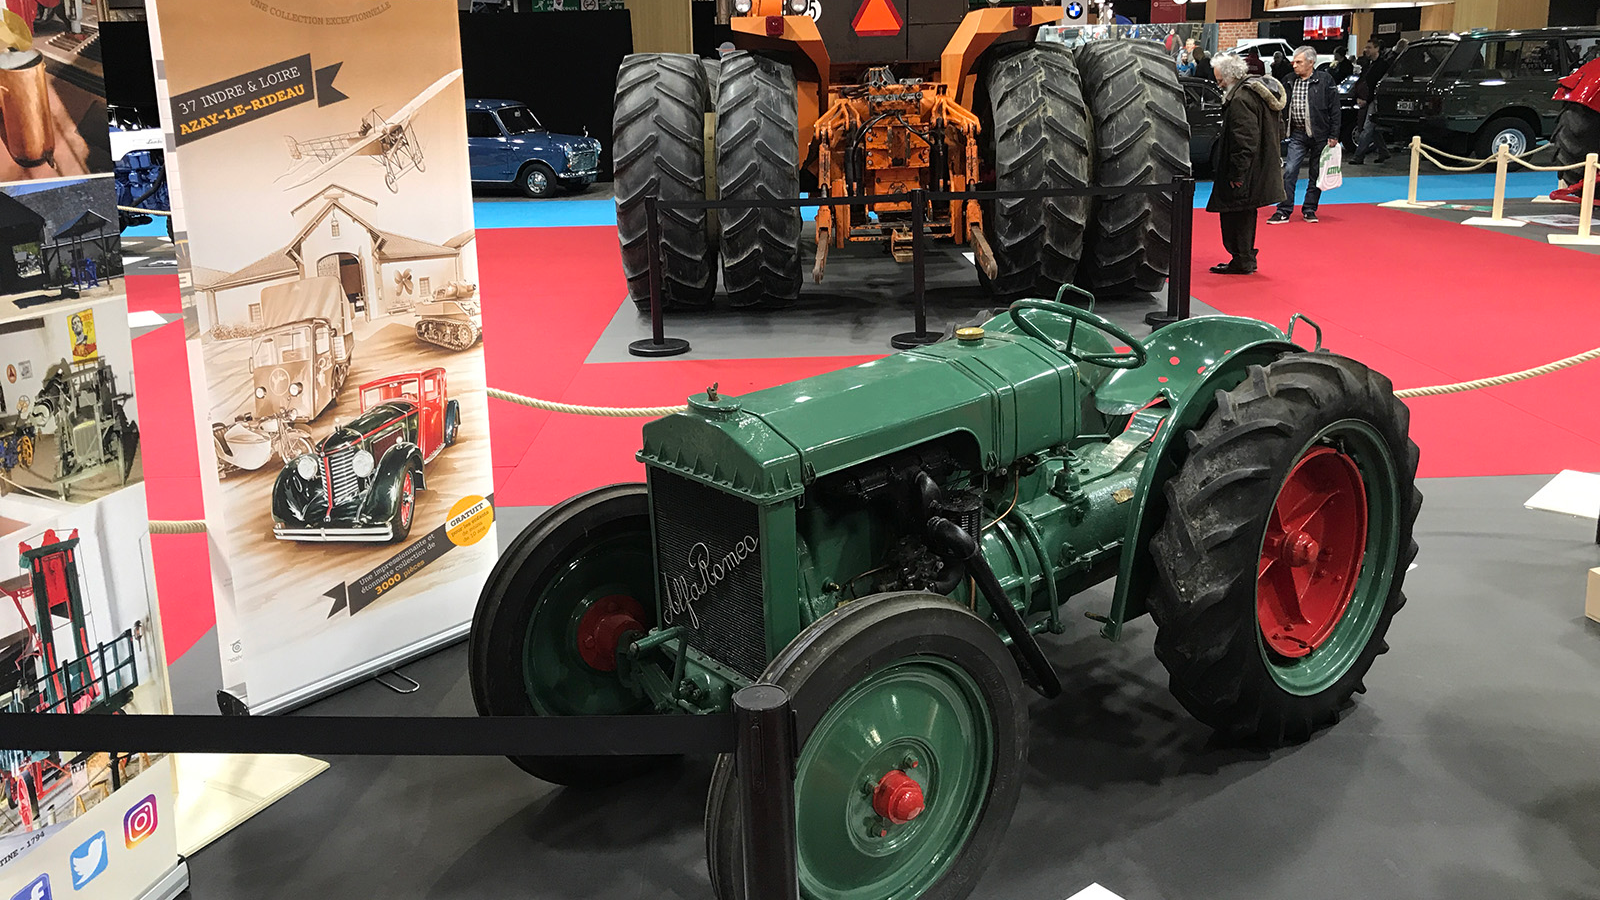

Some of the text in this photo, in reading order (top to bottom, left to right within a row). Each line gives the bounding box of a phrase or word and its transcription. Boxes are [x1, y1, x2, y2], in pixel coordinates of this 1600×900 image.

[250, 0, 391, 25] UNE COLLECTION EXCEPTIONNELLE
[179, 66, 300, 115] 37 INDRE & LOIRE
[180, 84, 305, 135] AZAY-LE-RIDEAU
[450, 502, 484, 527] GRATUIT
[471, 511, 489, 524] enfants
[359, 574, 373, 586] Une
[427, 533, 435, 541] et
[361, 542, 436, 594] étonnante collection de
[375, 559, 425, 595] 3000 pièces
[27, 831, 45, 848] 1794
